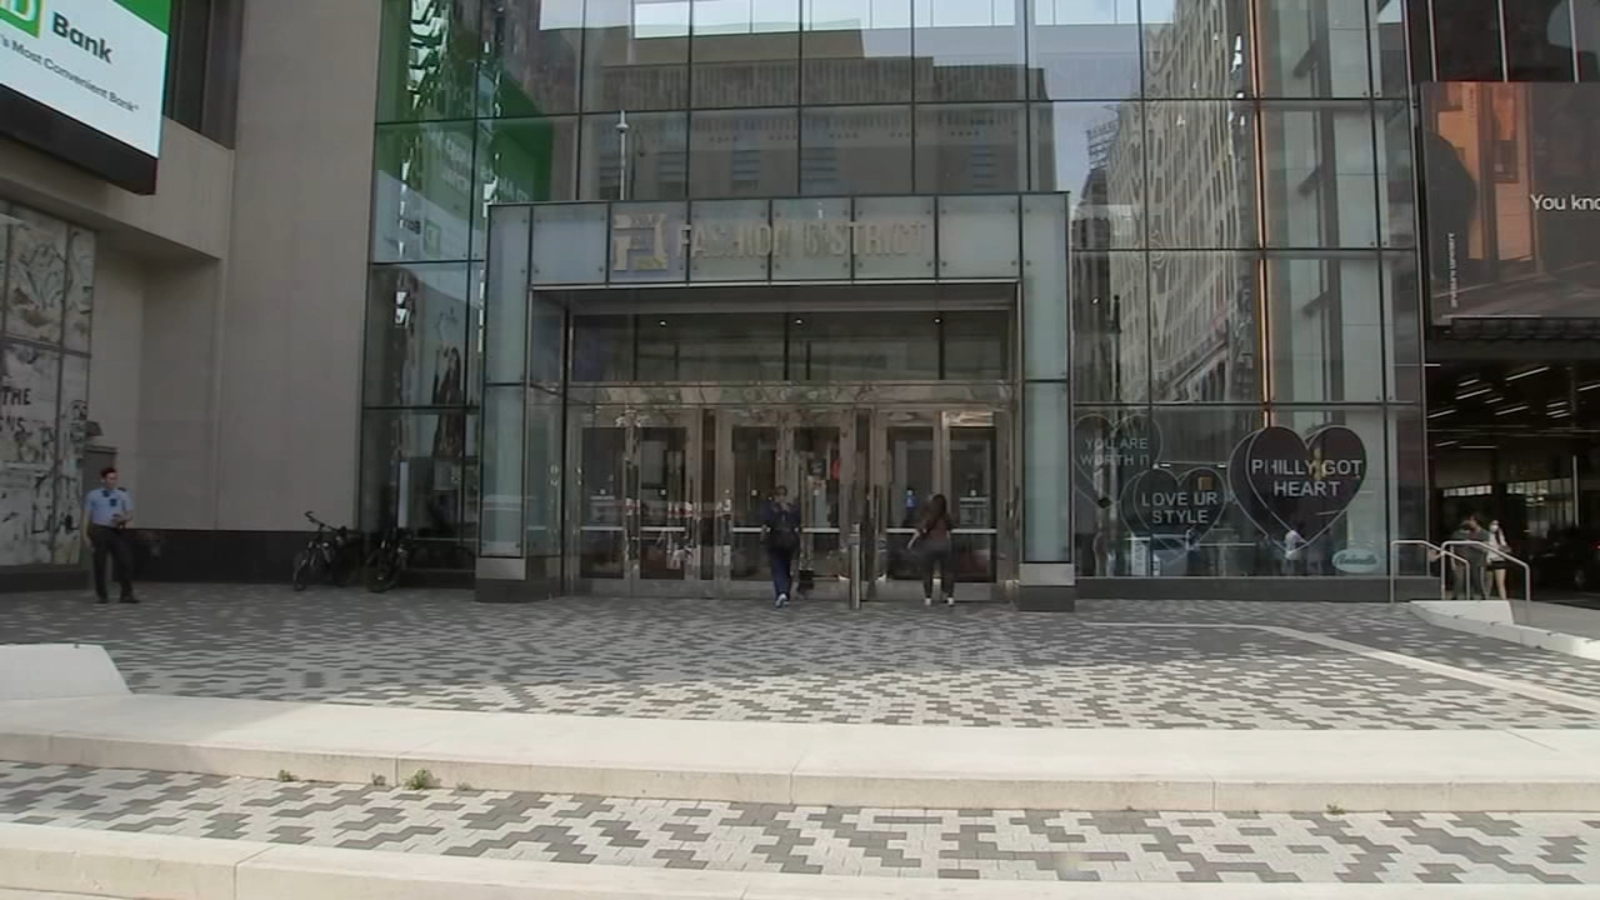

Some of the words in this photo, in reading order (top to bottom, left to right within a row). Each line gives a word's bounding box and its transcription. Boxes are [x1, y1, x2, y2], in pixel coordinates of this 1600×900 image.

[53, 12, 113, 64] Bank
[12, 40, 42, 65] Most
[43, 58, 108, 98] Convenient
[1529, 193, 1566, 211] You
[676, 223, 791, 257] FAHION
[1084, 437, 1115, 450] YOU
[1120, 437, 1149, 450] ARE
[1252, 459, 1317, 475] PHILLY
[1321, 459, 1362, 475] GOT
[1274, 481, 1340, 496] HEART
[1142, 491, 1188, 507] LOVE
[1194, 491, 1218, 506] UR
[1152, 509, 1209, 524] STYLE
